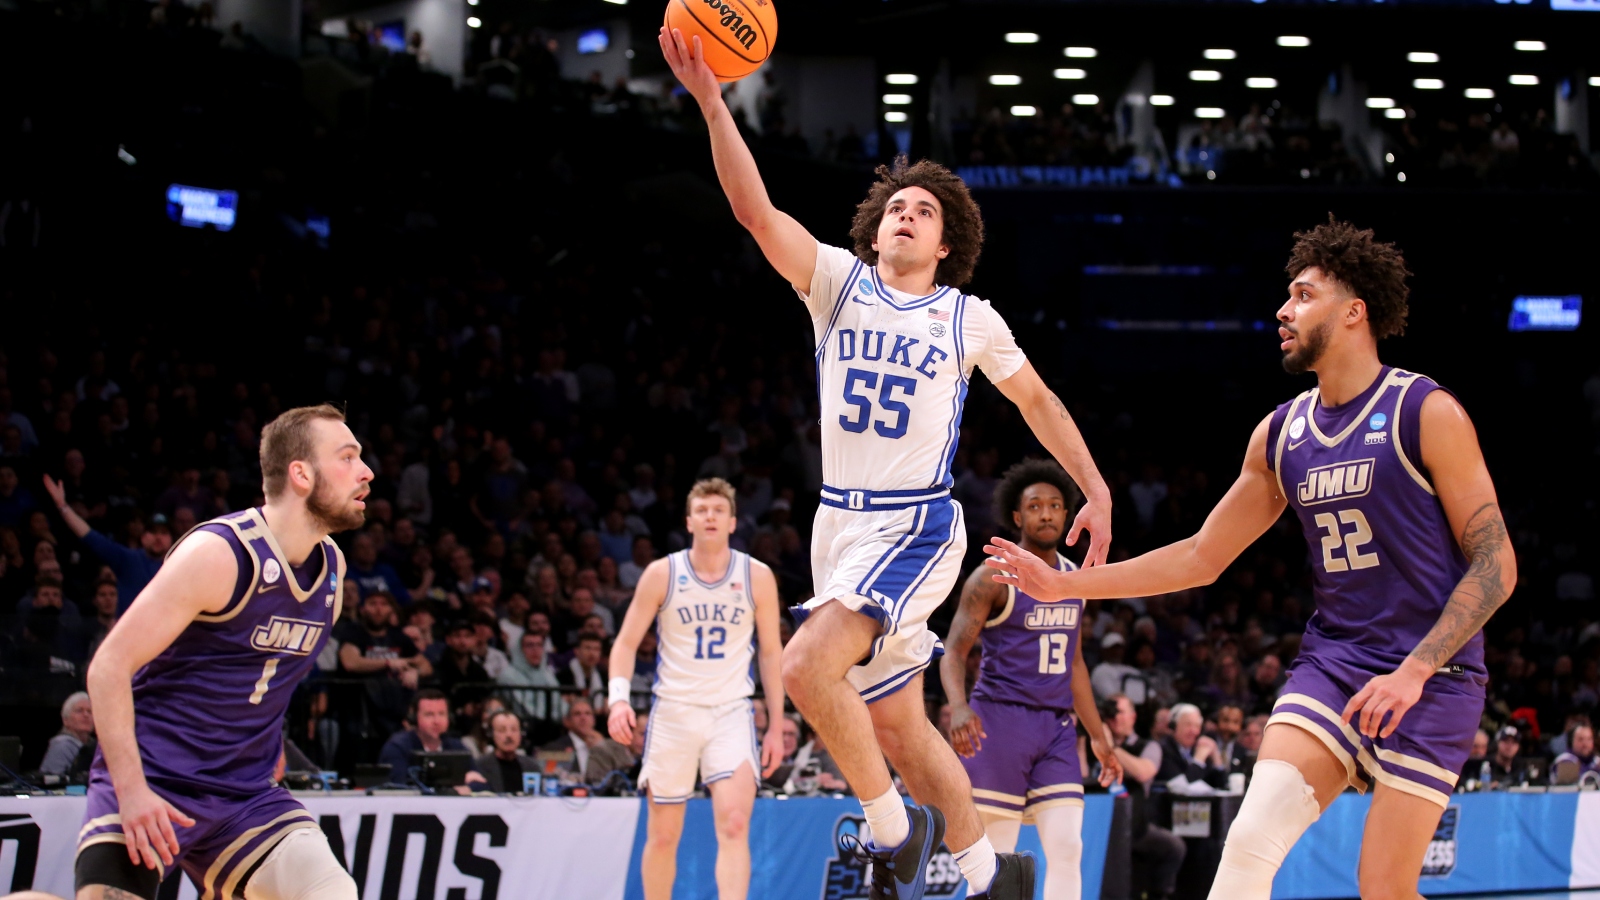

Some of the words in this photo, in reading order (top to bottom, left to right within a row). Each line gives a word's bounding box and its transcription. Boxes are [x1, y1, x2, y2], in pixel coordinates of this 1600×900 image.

[839, 329, 948, 380] DUKE
[839, 367, 917, 439] 55
[1300, 463, 1370, 502] JMU
[1314, 508, 1380, 572] 22
[677, 603, 745, 625] DUKE
[1027, 607, 1078, 627] JMU
[255, 620, 324, 652] JMU
[694, 626, 726, 659] 12
[1038, 632, 1069, 675] 13
[248, 658, 281, 705] 1
